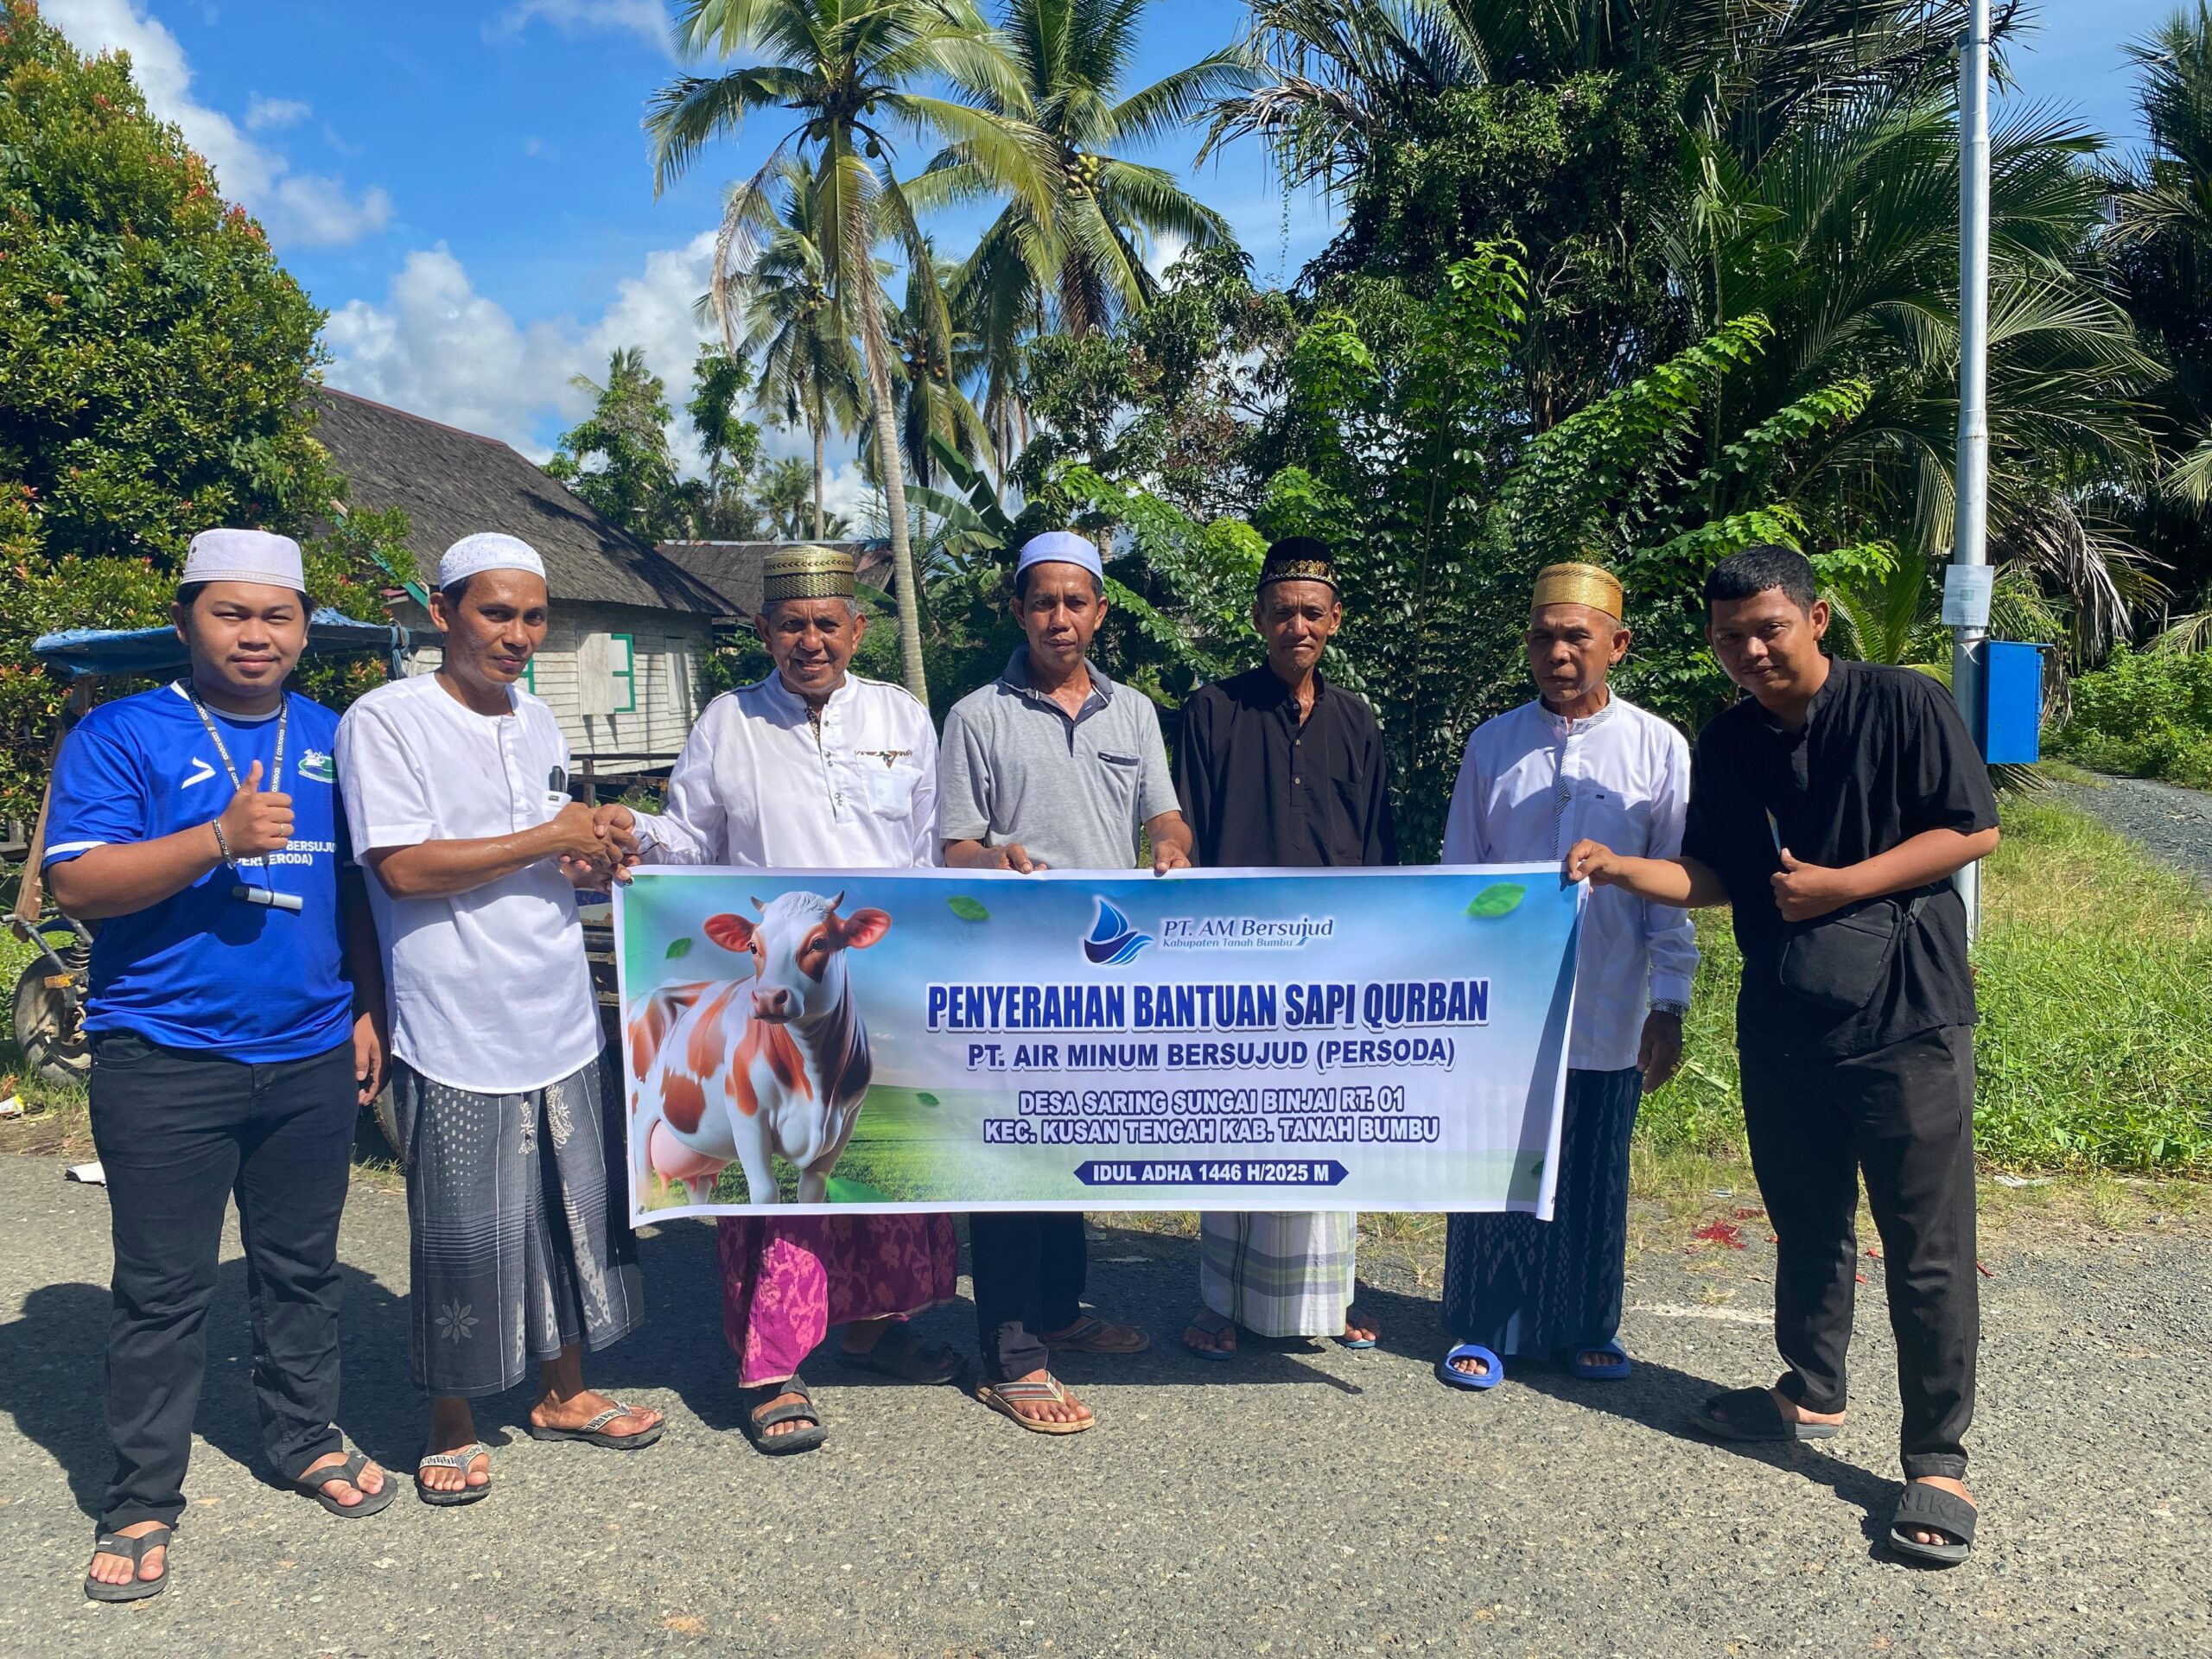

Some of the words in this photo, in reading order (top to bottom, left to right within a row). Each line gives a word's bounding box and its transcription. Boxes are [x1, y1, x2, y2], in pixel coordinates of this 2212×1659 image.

[286, 840, 337, 853] BERSUJU
[1164, 920, 1192, 937] PT.
[1198, 919, 1235, 938] AM
[1242, 918, 1333, 938] Bersujud
[1163, 938, 1219, 949] Kabupaten
[1223, 938, 1253, 947] Tanah
[1256, 938, 1293, 947] Bumbu
[928, 985, 1126, 1028] PENYERAHAN
[1134, 984, 1277, 1027] BANTUAN
[1284, 983, 1356, 1026] SAPI
[1363, 980, 1489, 1028] QURBAN
[968, 1044, 1005, 1066] PT.
[1013, 1044, 1059, 1067] AIR
[1066, 1043, 1159, 1067] MINUM
[1166, 1041, 1308, 1066] BERSUJUD
[1316, 1037, 1455, 1070] (PERSODA)
[1020, 1090, 1079, 1116] DESA
[1083, 1090, 1167, 1116] SARING
[1173, 1088, 1258, 1115] SUNGAI
[1263, 1087, 1337, 1113] BINJAI
[1340, 1086, 1375, 1112] RT.
[1378, 1085, 1405, 1112] 01
[984, 1119, 1038, 1143] KEC.
[1042, 1119, 1120, 1143] KUSAN
[1123, 1119, 1217, 1143] TENGAH
[1220, 1118, 1274, 1143] KAB.
[1279, 1117, 1354, 1142] TANAH
[1358, 1116, 1440, 1142] BUMBU
[1093, 1165, 1137, 1181] IDUL
[1141, 1165, 1193, 1181] ADHA
[1198, 1164, 1242, 1181] 1446
[1247, 1164, 1309, 1181] H/2025
[1313, 1164, 1329, 1181] M
